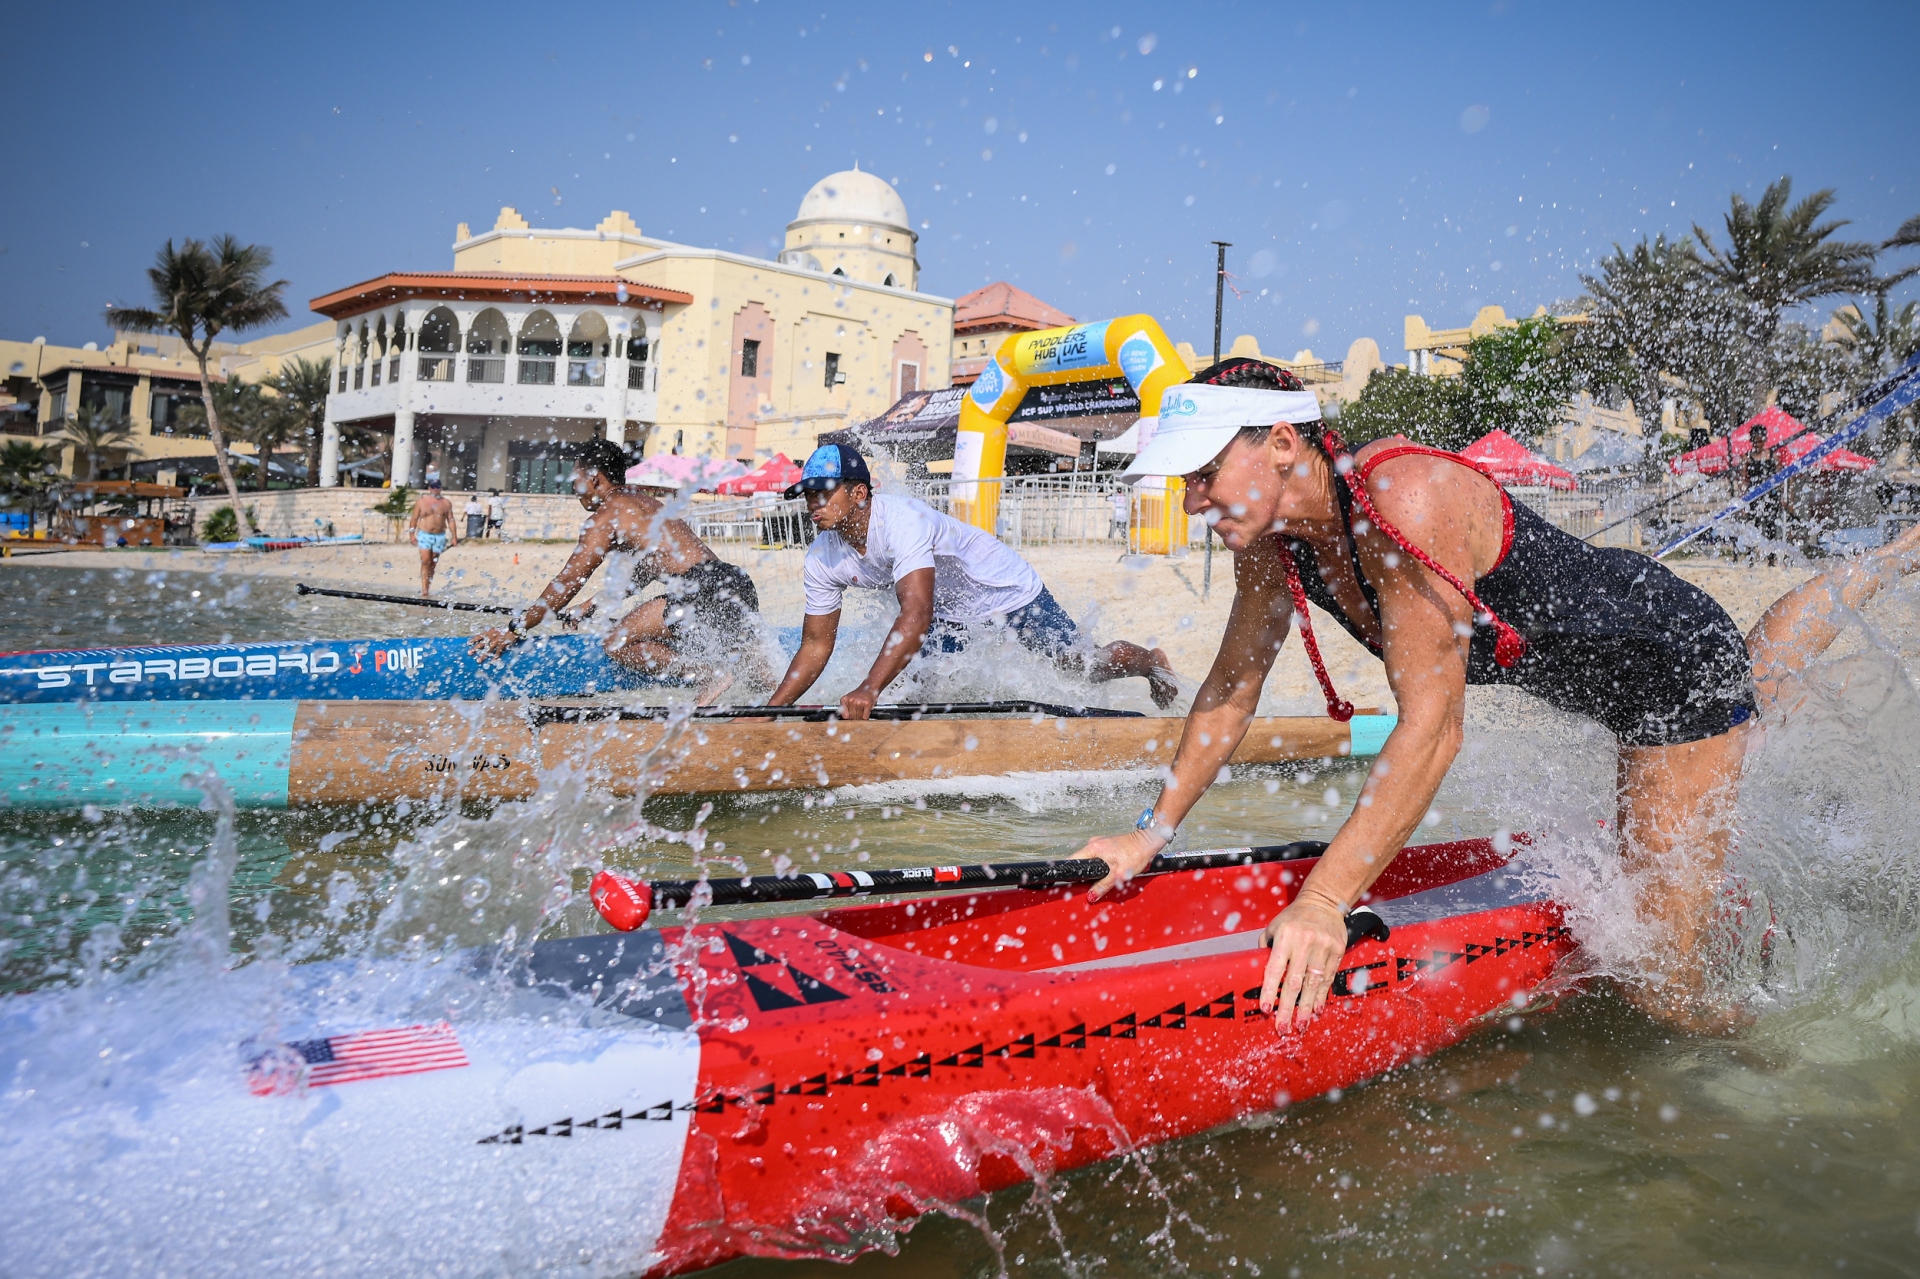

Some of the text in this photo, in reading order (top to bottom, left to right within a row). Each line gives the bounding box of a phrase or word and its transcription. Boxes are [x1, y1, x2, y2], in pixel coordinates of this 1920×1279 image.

[1028, 330, 1088, 350] PADDLERS
[1034, 347, 1057, 361] HUB
[1021, 398, 1137, 417] ICF SUP WORLD CHAMPIONSHIPS
[901, 869, 933, 879] BLACK
